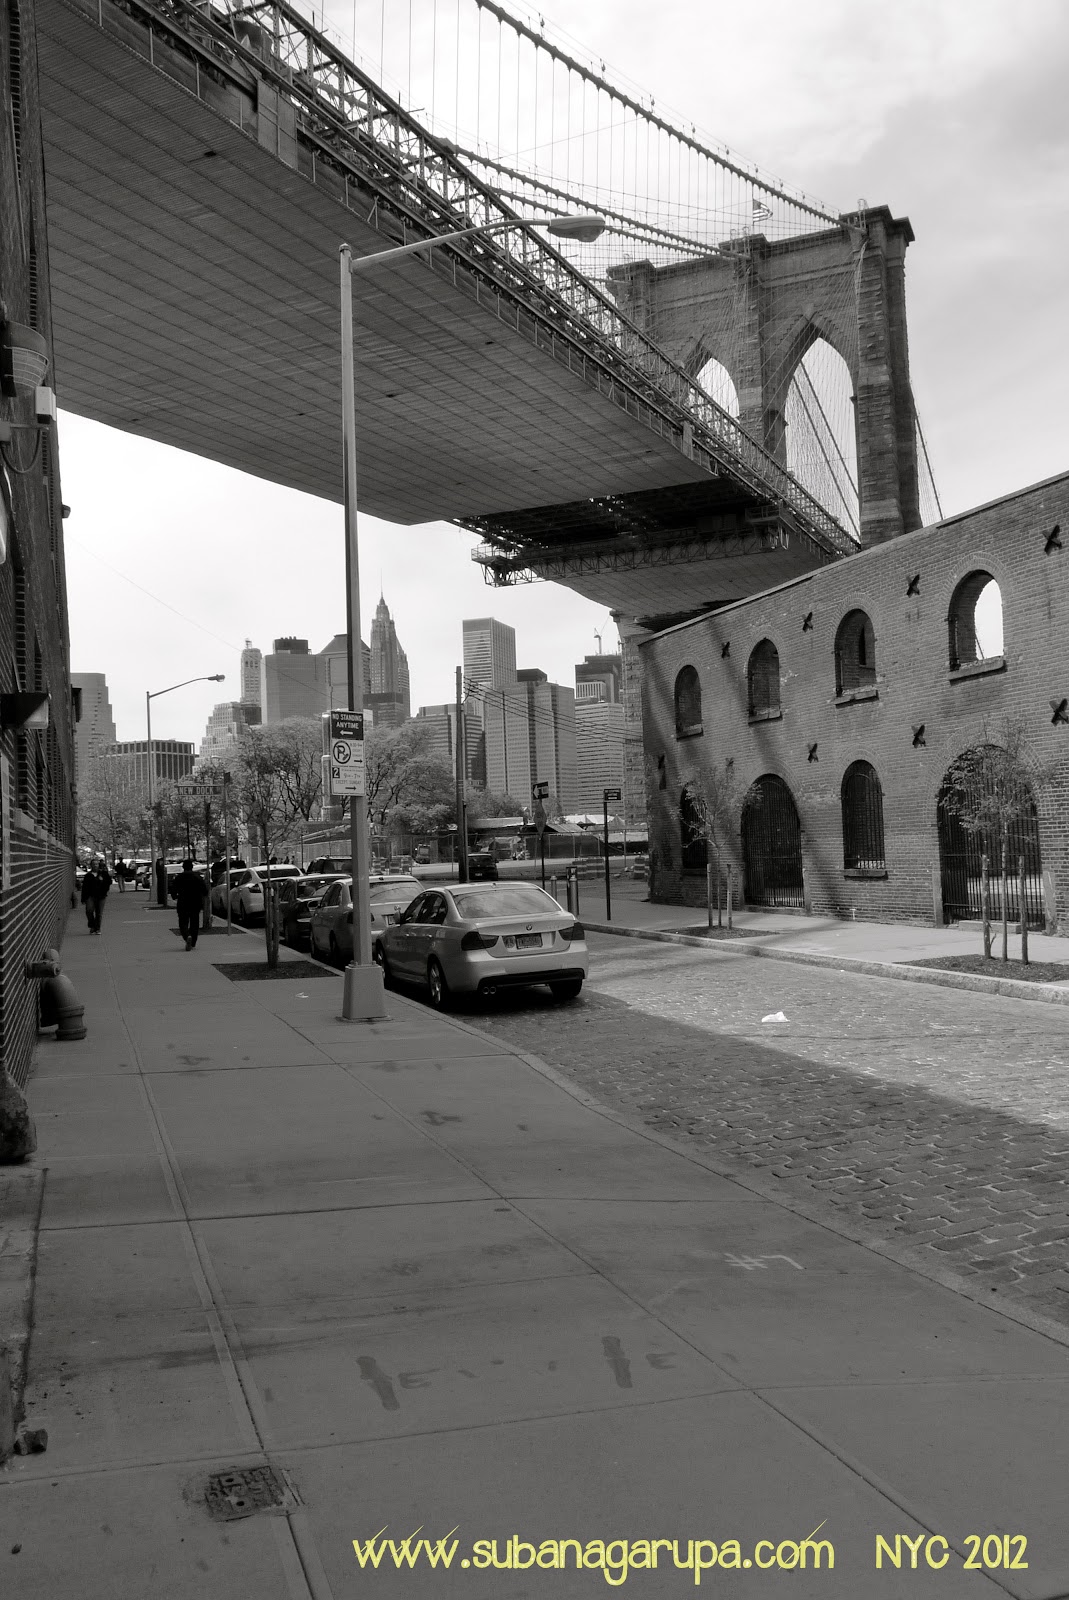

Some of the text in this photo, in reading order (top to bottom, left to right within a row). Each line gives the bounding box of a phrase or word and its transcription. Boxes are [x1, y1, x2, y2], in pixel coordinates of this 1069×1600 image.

[340, 713, 362, 722] STANDING
[336, 721, 360, 729] ANYTIME
[333, 767, 339, 778] 2
[179, 786, 194, 795] NEW
[196, 786, 214, 795] DOCK
